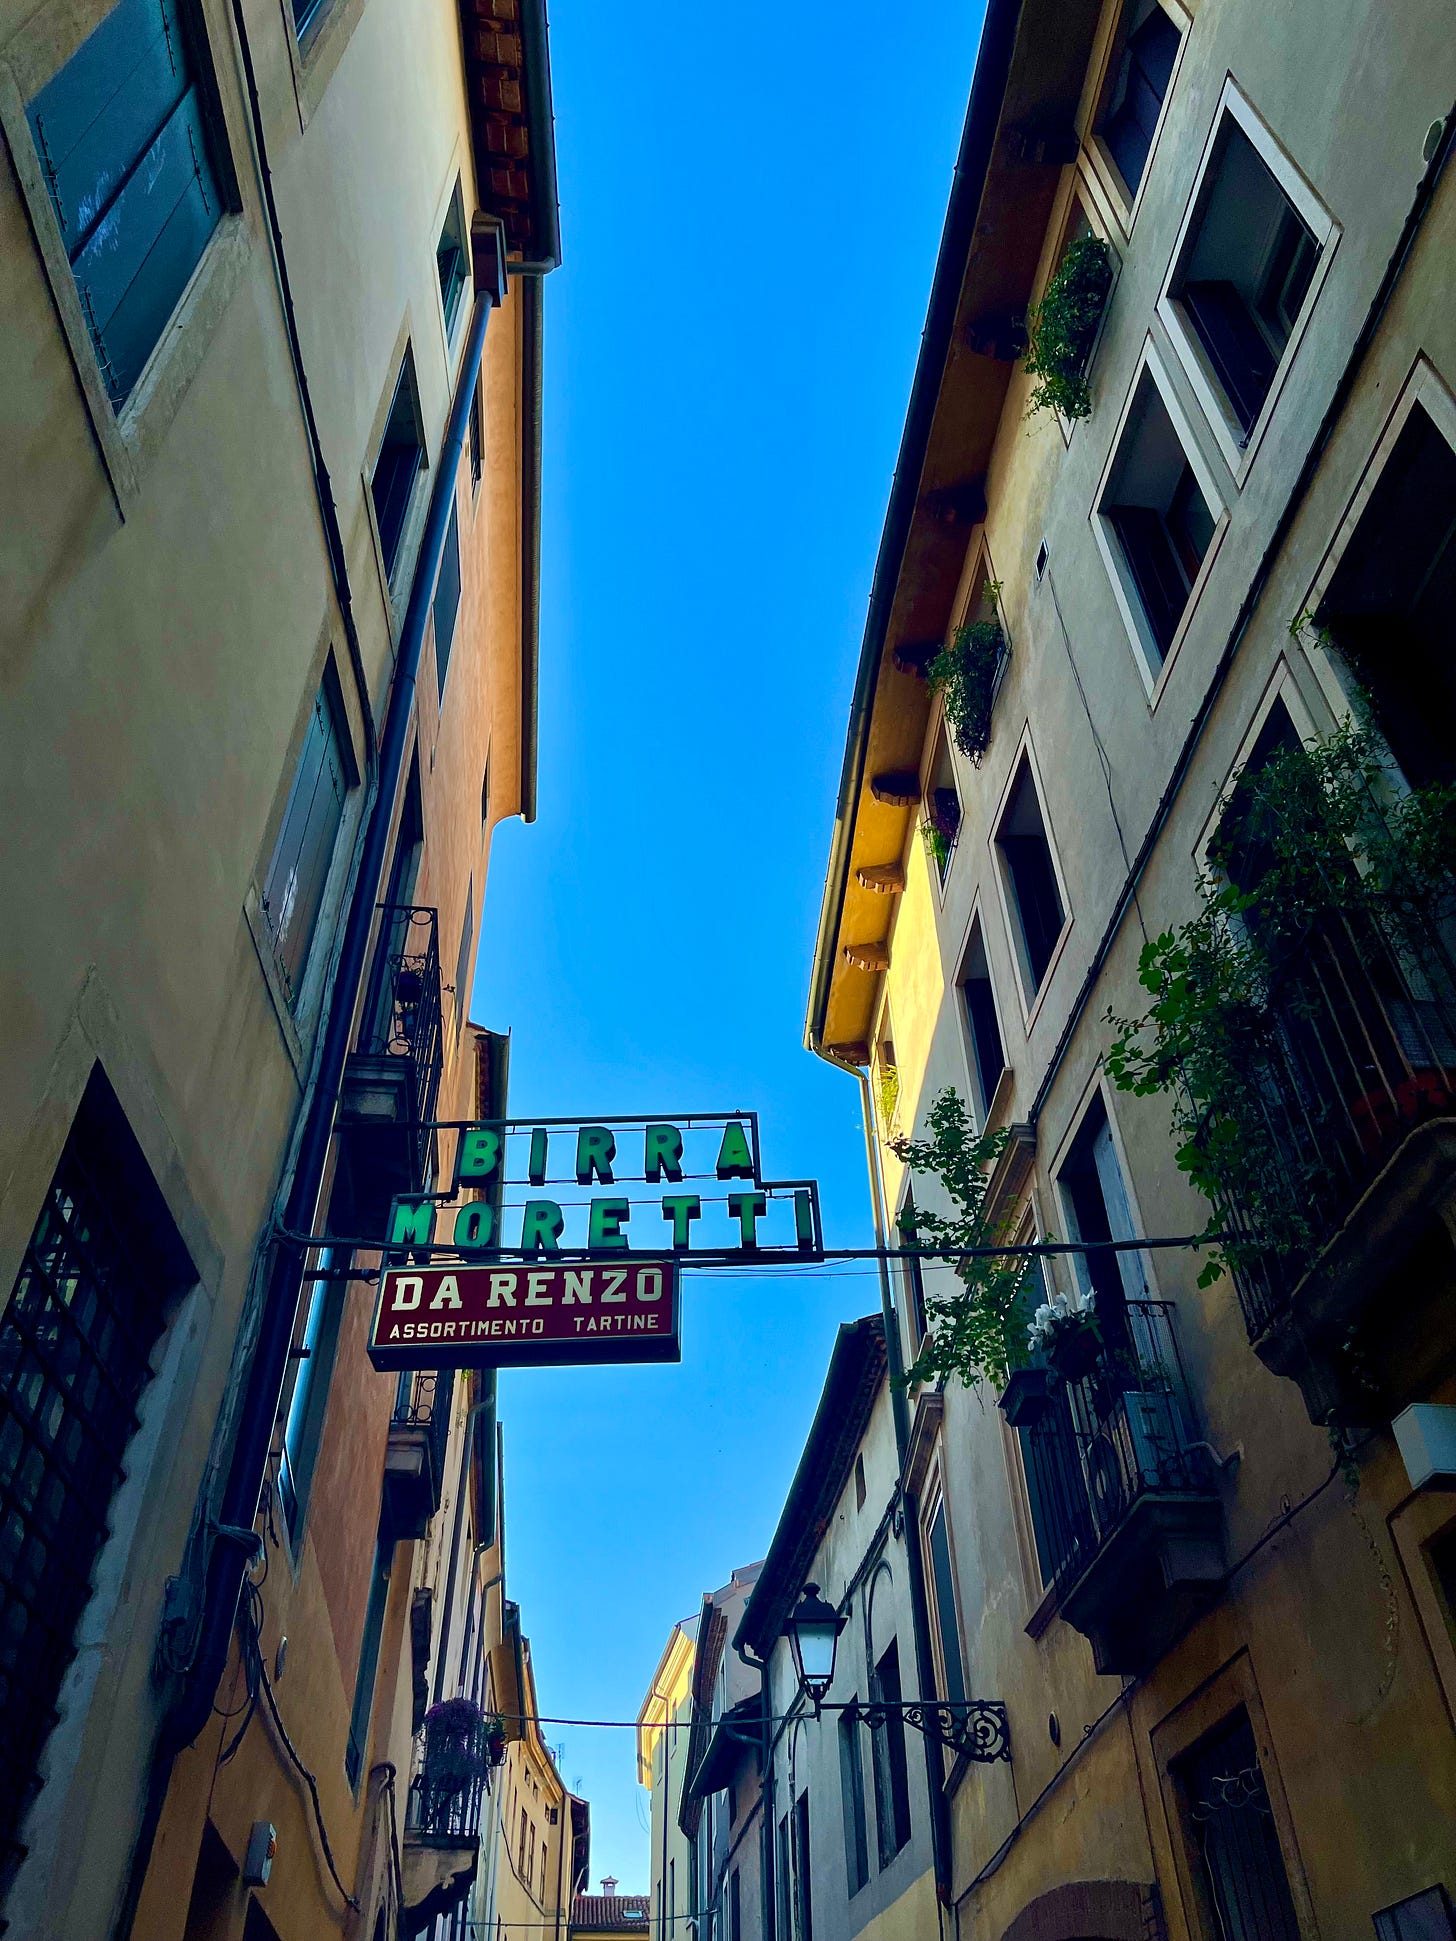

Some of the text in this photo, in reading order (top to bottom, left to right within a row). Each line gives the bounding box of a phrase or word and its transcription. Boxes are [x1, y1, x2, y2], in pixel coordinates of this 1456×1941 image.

[459, 1121, 754, 1187] BIRRA
[391, 1190, 814, 1260] MORETTI
[391, 1267, 664, 1311] DA RENZO
[389, 1313, 659, 1340] ASSORTIMENTO TARTINE
